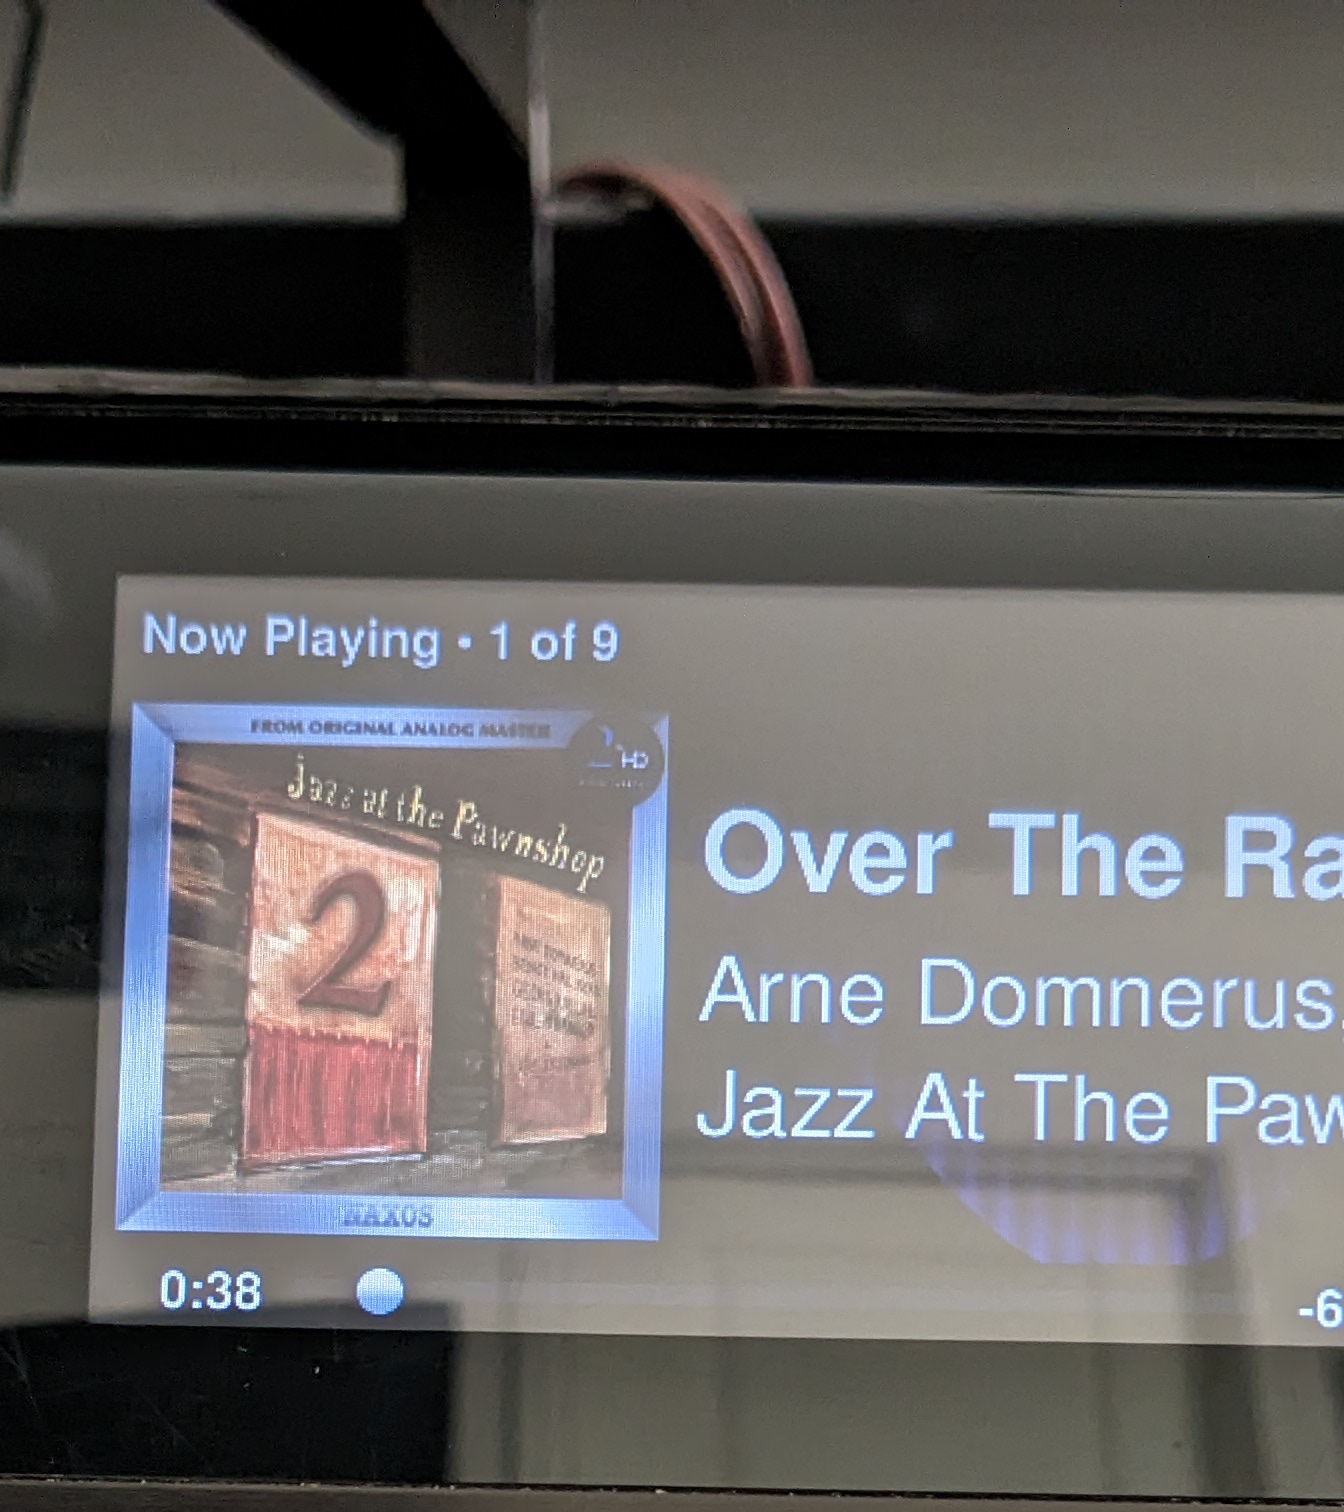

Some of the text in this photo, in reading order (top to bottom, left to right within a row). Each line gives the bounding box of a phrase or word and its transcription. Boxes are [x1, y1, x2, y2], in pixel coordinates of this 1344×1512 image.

[142, 613, 619, 669] Now Playing 1 of 9
[250, 718, 303, 734] FROM
[308, 720, 396, 736] ORIGINAL
[400, 721, 474, 738] ANALOG
[396, 783, 445, 830] the
[451, 798, 606, 895] Pawnshop
[703, 808, 954, 897] Over
[987, 812, 1184, 900] The
[296, 868, 392, 1017] 2
[697, 954, 884, 1027] Arne
[695, 1068, 876, 1140] Jazz
[903, 1071, 986, 1143] At
[1013, 1072, 1170, 1145] The
[159, 1268, 262, 1311] 0:38
